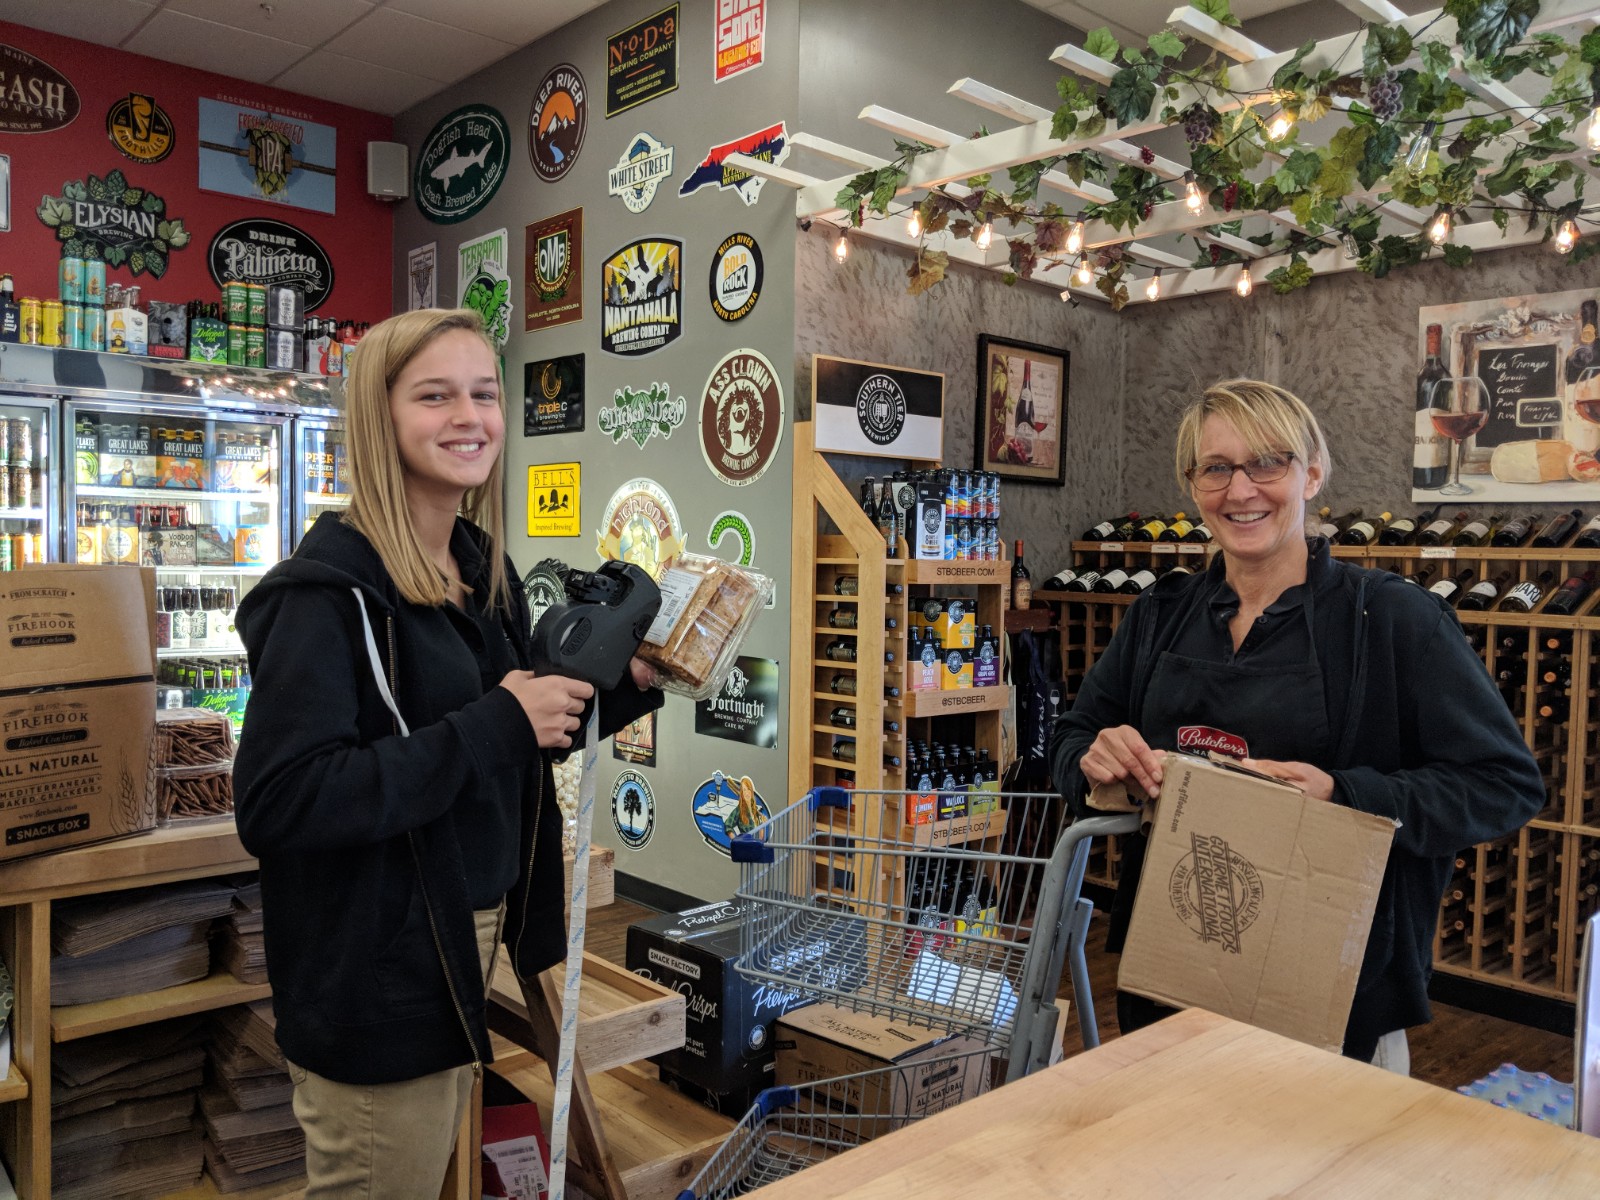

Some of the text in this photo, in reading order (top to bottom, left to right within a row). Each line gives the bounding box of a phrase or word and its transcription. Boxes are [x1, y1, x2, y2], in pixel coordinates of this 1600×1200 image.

[719, 7, 761, 51] SONG
[610, 42, 672, 76] BREWING COMPANY
[531, 73, 583, 126] DEEP RIVER
[118, 129, 165, 154] FOOTHILLS
[426, 121, 491, 170] Dogfish Head
[261, 138, 282, 174] IPA
[611, 165, 637, 190] WHITE
[638, 153, 670, 180] STREET
[424, 161, 497, 208] Craft Brewed Ales
[75, 201, 155, 239] ELYSIAN
[98, 229, 134, 240] BREWING
[249, 230, 297, 247] DRINK
[718, 235, 754, 257] MILLS RIVER
[219, 238, 318, 279] Palmetto
[460, 236, 503, 281] TERRAPIN
[540, 236, 566, 281] OMB
[724, 252, 747, 279] BOLD
[724, 266, 747, 292] ROCK
[605, 291, 679, 338] NANTAHALA
[713, 292, 758, 321] NORTH CAROLINA
[195, 321, 224, 329] STONE
[641, 324, 670, 340] COMPANY
[709, 358, 773, 405] ASS CLOWN
[537, 401, 568, 415] triple C
[858, 378, 905, 422] SOUTHERN TIER
[108, 439, 149, 451] GREAT LAKES
[864, 425, 898, 442] BREWING CO
[164, 442, 203, 454] GREAT LAKES
[225, 446, 261, 456] GREAT LAKES
[534, 470, 575, 487] BELL'S
[169, 532, 194, 541] VOODOO
[936, 567, 995, 577] STBCBEER.COM
[10, 590, 67, 599] FROM SCRATCH
[8, 620, 75, 632] FIREHOOK
[942, 695, 986, 707] @STBCBEER
[4, 712, 88, 733] FIREHOOK
[714, 712, 759, 726] BREWING COMPANY
[1180, 728, 1247, 755] Butcher's
[30, 752, 98, 773] NATURAL
[0, 777, 94, 798] MEDITERRANEAN
[0, 786, 94, 809] BAKED CRACKERS
[613, 774, 653, 809] PALMETTO BREWING
[1170, 771, 1192, 833] www.gfifoods.com
[16, 818, 80, 841] SNACK BOX
[933, 821, 991, 839] STBCBEER.COM
[1195, 834, 1221, 943] INTERNATIONAL
[1209, 835, 1237, 954] GOURMET FOODS
[650, 952, 699, 977] SNACK FACTORY
[828, 1025, 867, 1041] CRUNCH
